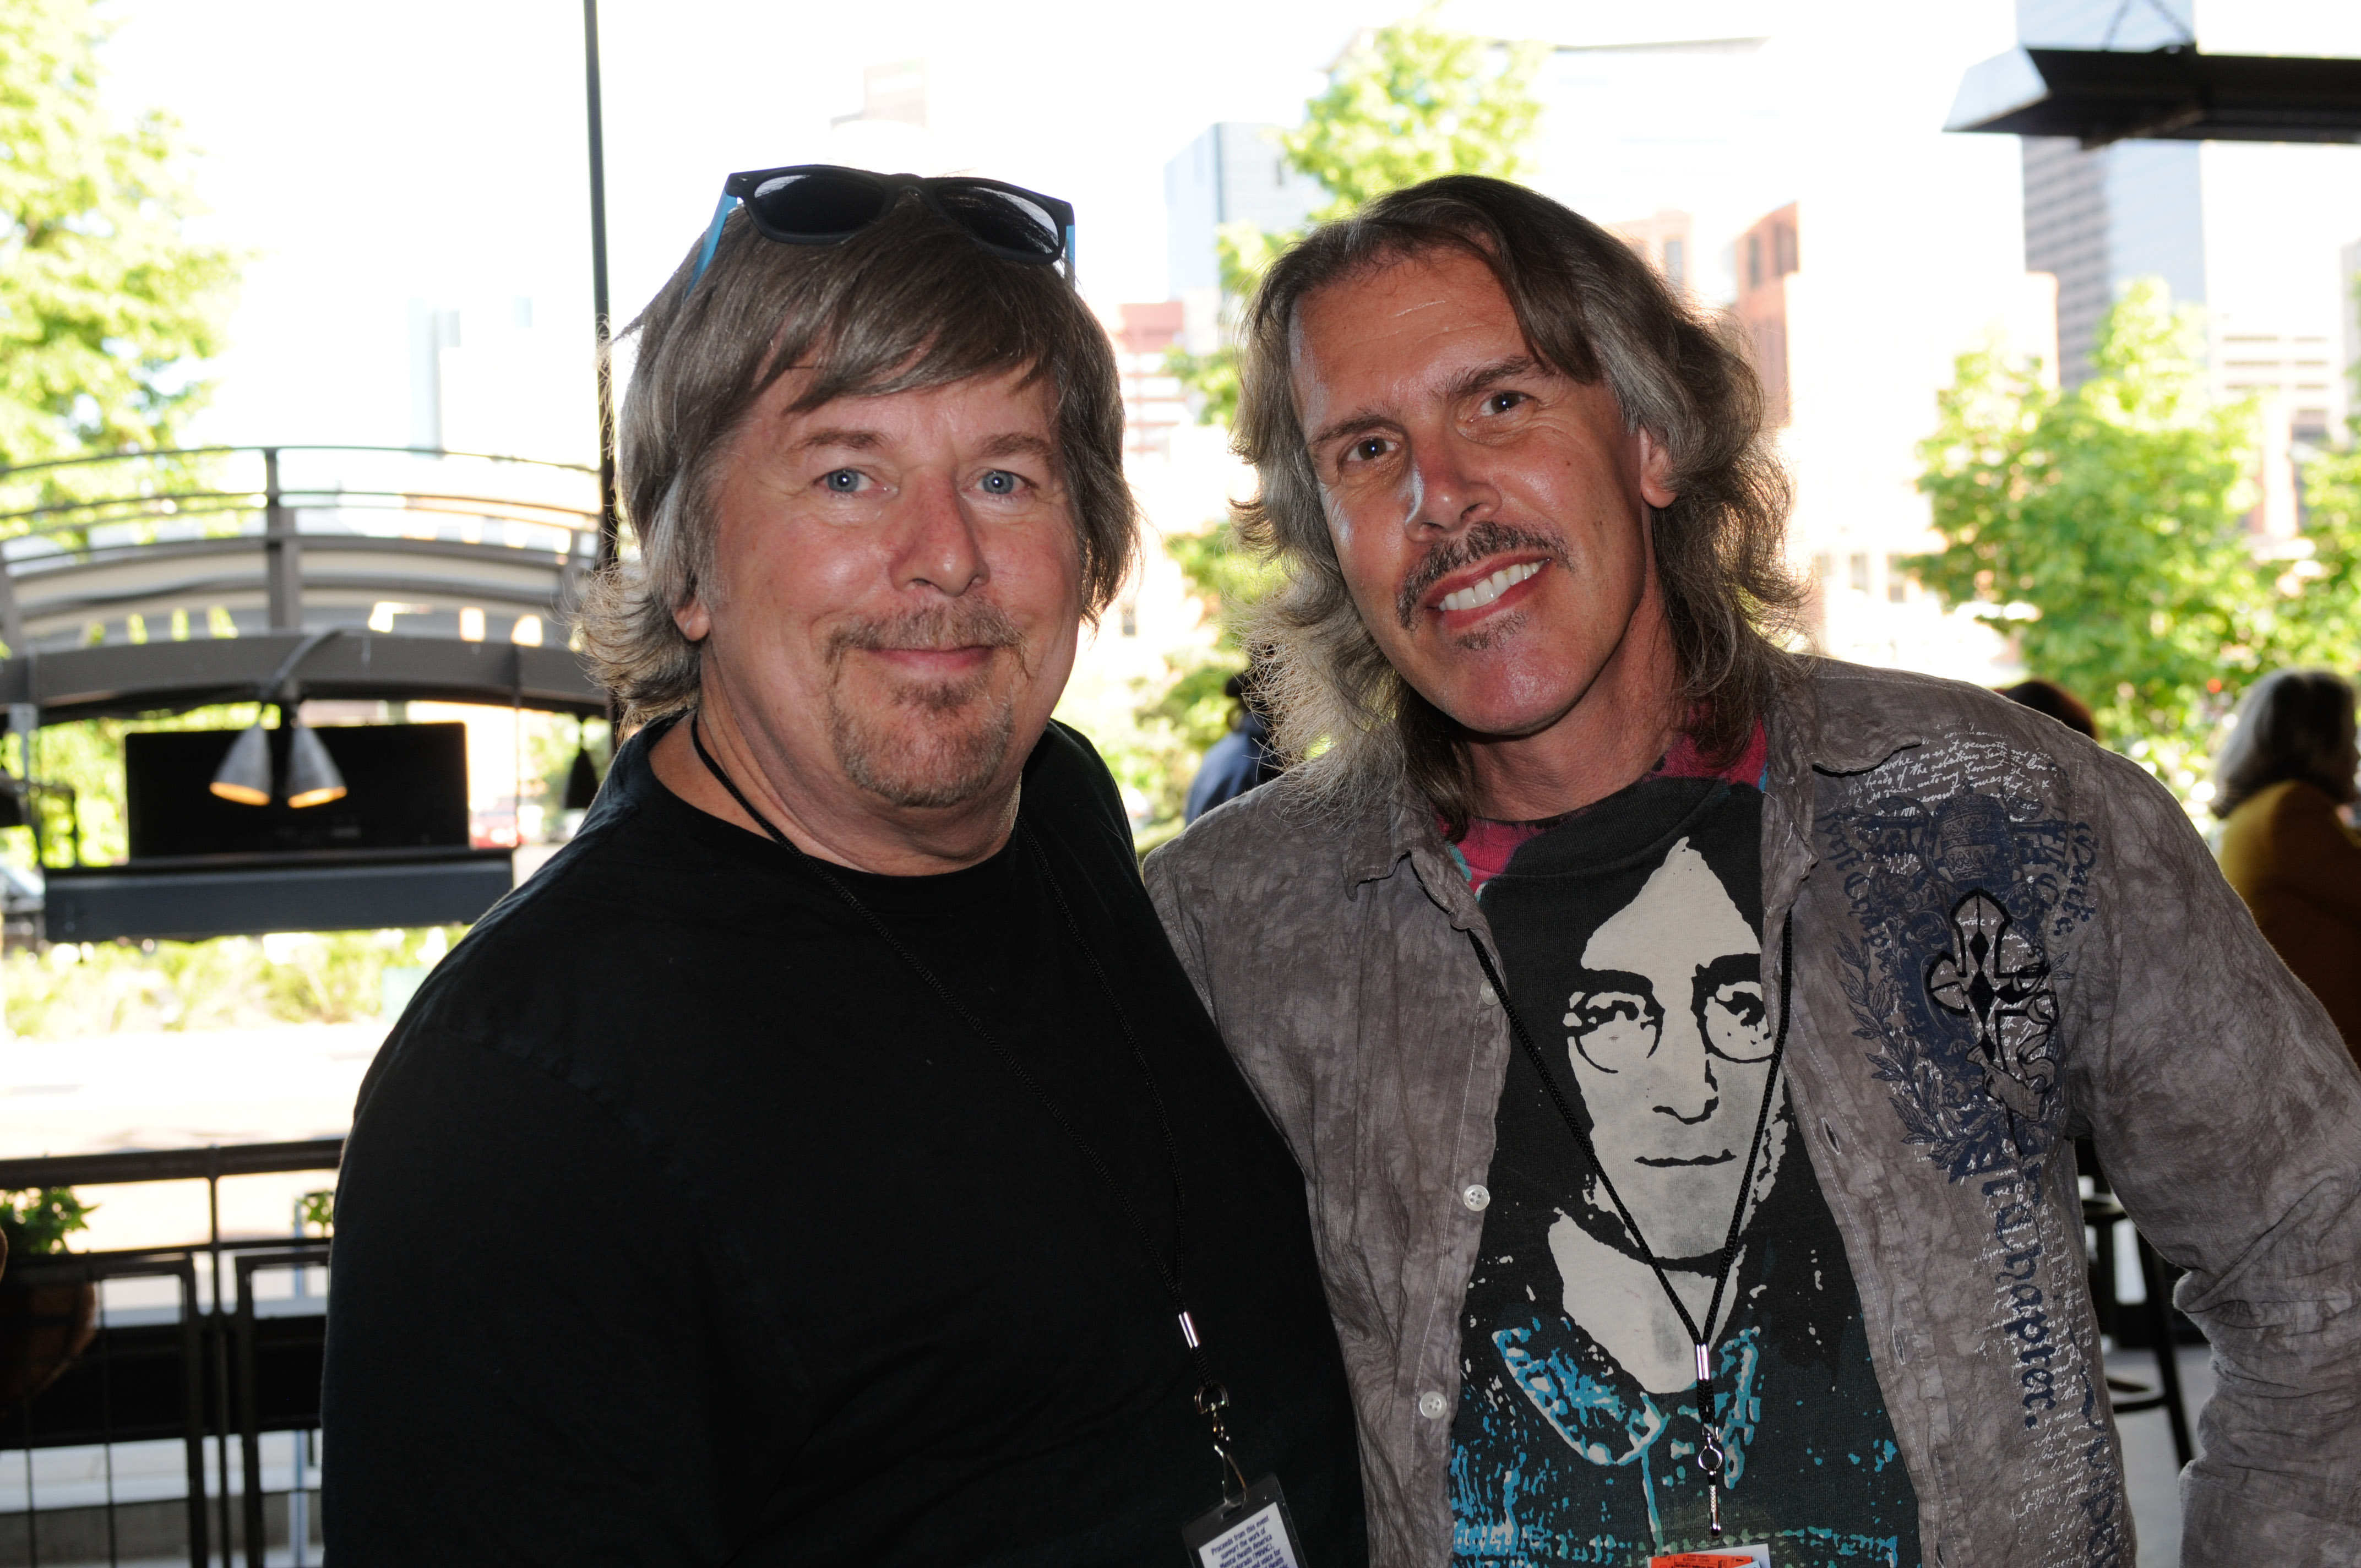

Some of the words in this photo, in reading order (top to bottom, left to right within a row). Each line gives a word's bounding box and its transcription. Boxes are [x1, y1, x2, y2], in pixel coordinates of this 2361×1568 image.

[1211, 1538, 1233, 1555] Proceeds
[1234, 1531, 1246, 1541] from
[1246, 1524, 1256, 1533] this
[1256, 1515, 1269, 1527] event
[1221, 1544, 1239, 1560] support
[1239, 1539, 1248, 1548] the
[1248, 1532, 1260, 1542] work
[1261, 1527, 1266, 1535] of
[1237, 1547, 1253, 1559] Health
[1253, 1534, 1272, 1550] America
[1261, 1554, 1274, 1565] voice
[1269, 1556, 1284, 1568] Health
